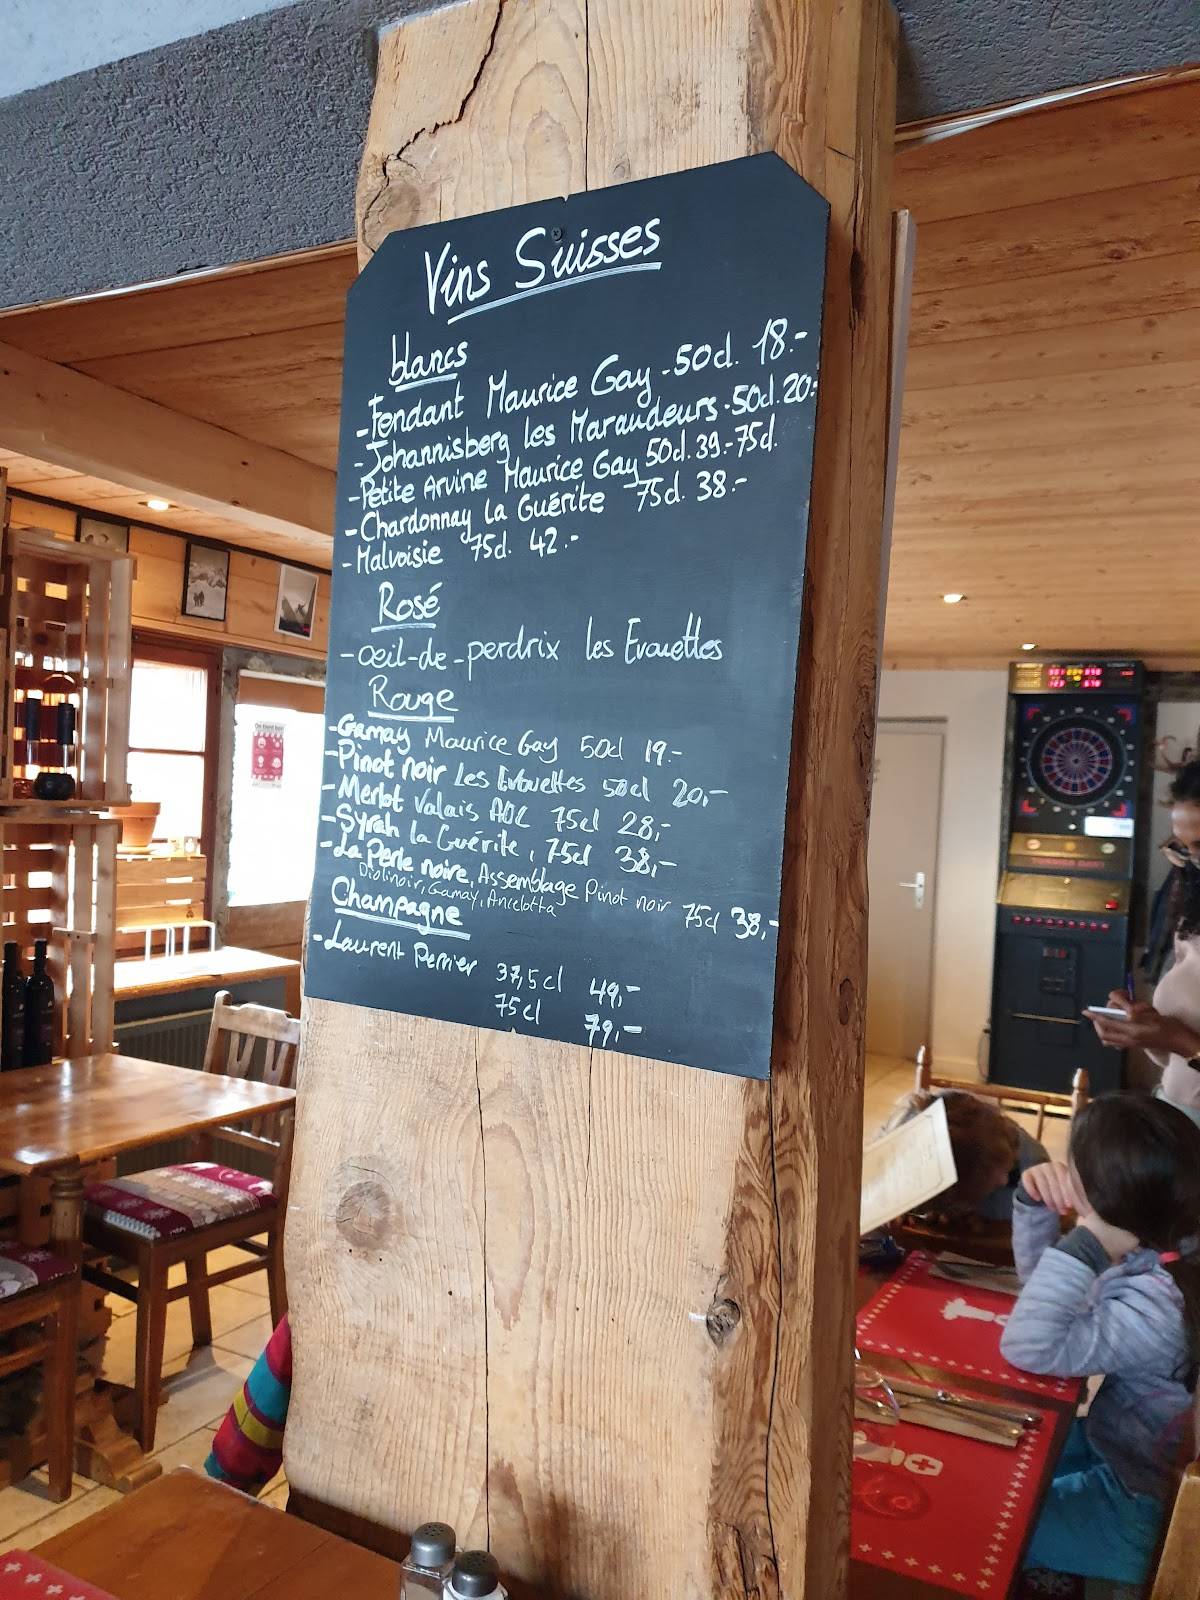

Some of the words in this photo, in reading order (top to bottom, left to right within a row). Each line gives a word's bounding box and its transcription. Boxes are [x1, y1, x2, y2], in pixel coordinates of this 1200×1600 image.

[425, 242, 490, 314] Vins
[515, 218, 661, 289] Suisses
[389, 331, 468, 385] blancs
[487, 369, 578, 419] Maurice
[591, 354, 651, 408] Gay
[570, 396, 718, 444] Maraudeurs
[424, 468, 487, 501] Arvine
[505, 454, 584, 493] Maurice
[593, 449, 639, 488] Gay
[518, 480, 605, 521] Guérite
[379, 581, 442, 624] Rosé
[368, 674, 459, 716] Rouge
[425, 726, 512, 755] Maurice
[517, 729, 559, 763] Gay
[401, 756, 447, 784] noir
[453, 762, 490, 788] Les
[415, 787, 479, 821] Valais
[489, 796, 531, 828] AOC
[550, 805, 600, 832] 75cl
[546, 838, 592, 867] 75cl
[366, 837, 413, 872] Perle
[478, 862, 579, 905] Assemblage
[585, 878, 628, 905] Pinot
[636, 896, 672, 913] noir
[331, 876, 464, 935] Champagne
[413, 941, 477, 977] Perrier
[495, 993, 541, 1025] 75cl
